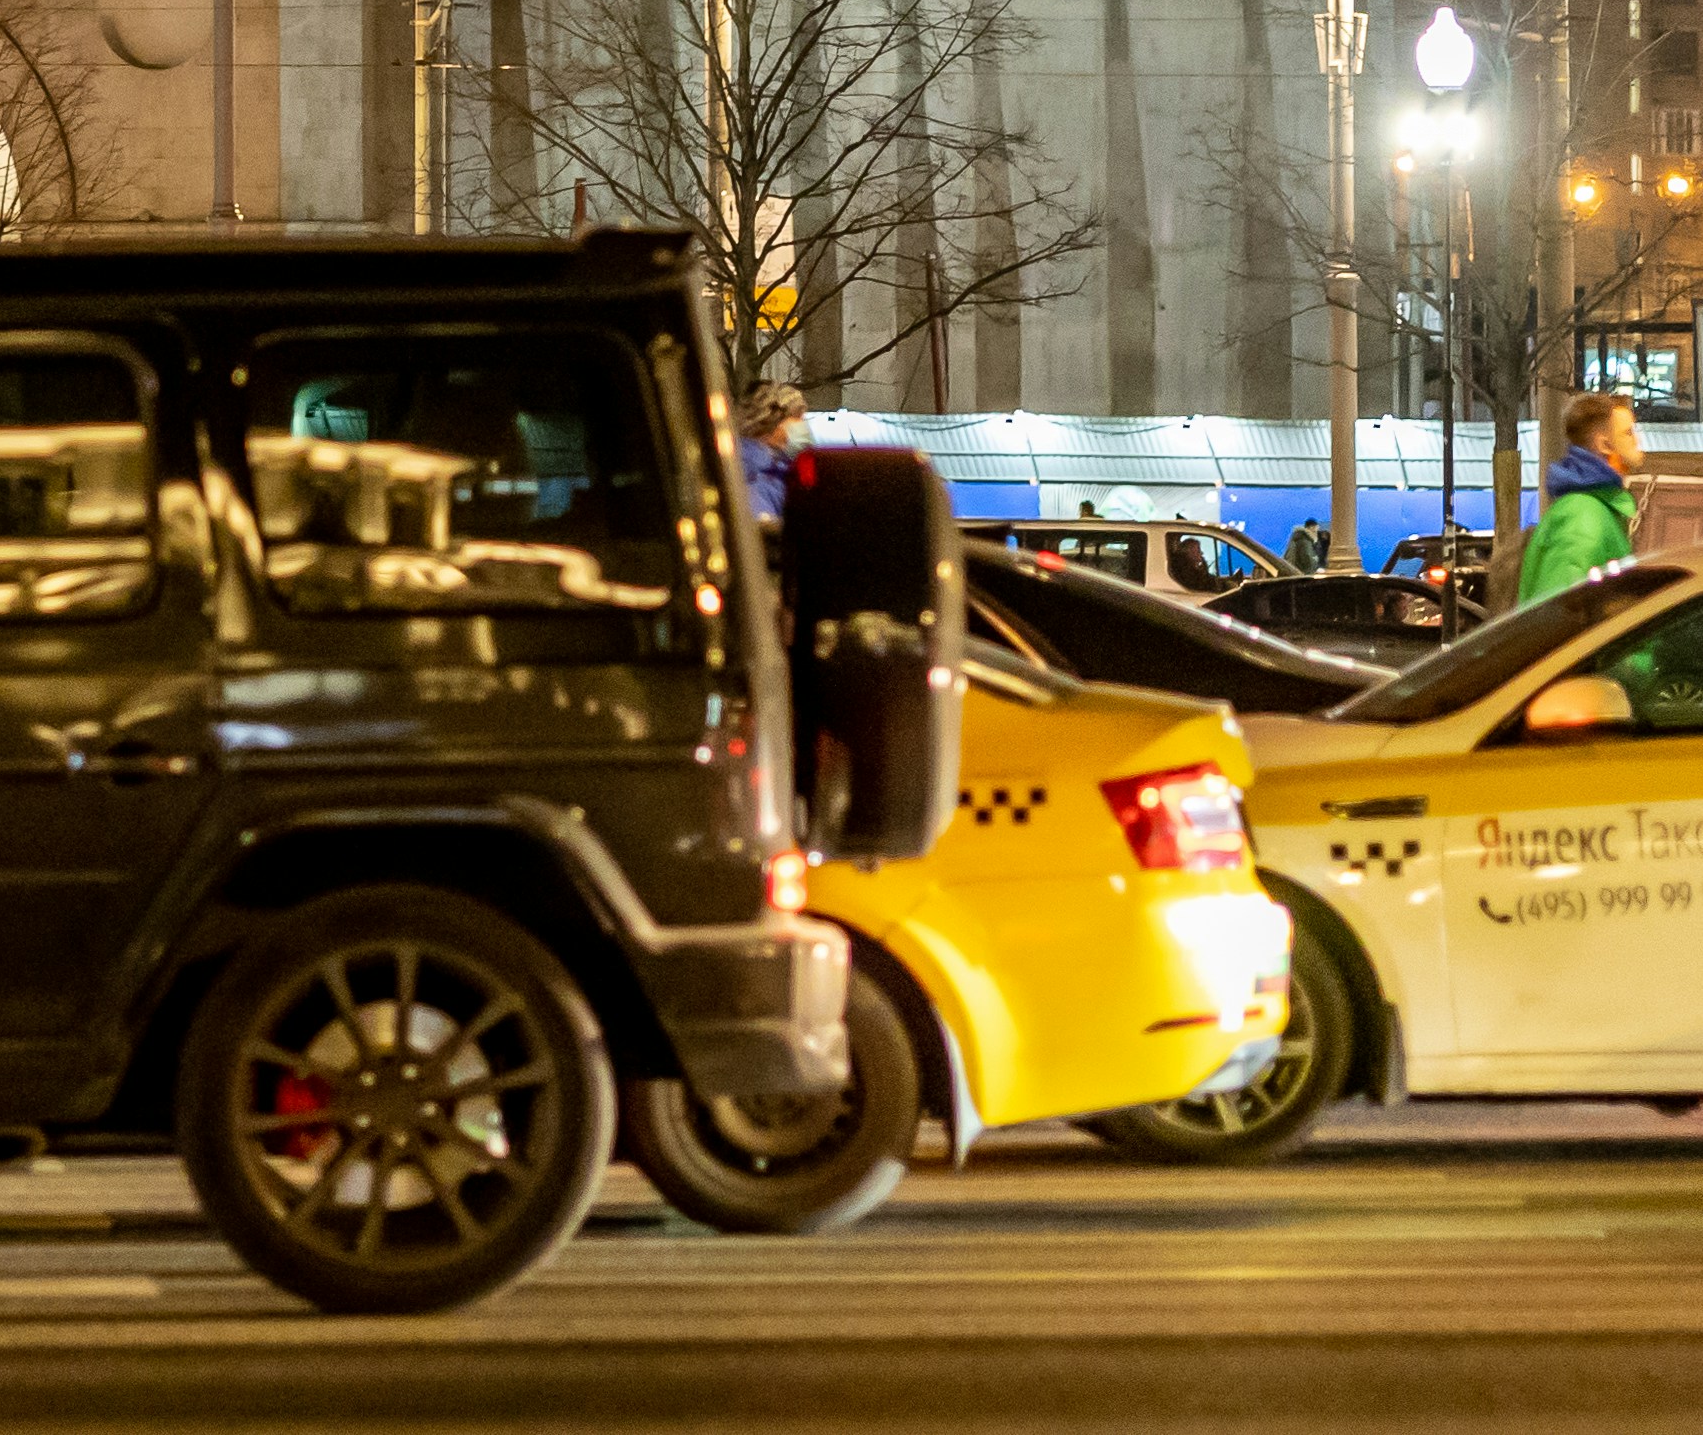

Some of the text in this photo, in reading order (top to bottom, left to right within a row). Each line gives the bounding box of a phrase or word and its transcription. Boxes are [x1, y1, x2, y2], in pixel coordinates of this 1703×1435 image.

[1477, 816, 1619, 869] Яндекс
[1517, 880, 1693, 925] (495) 999 99
